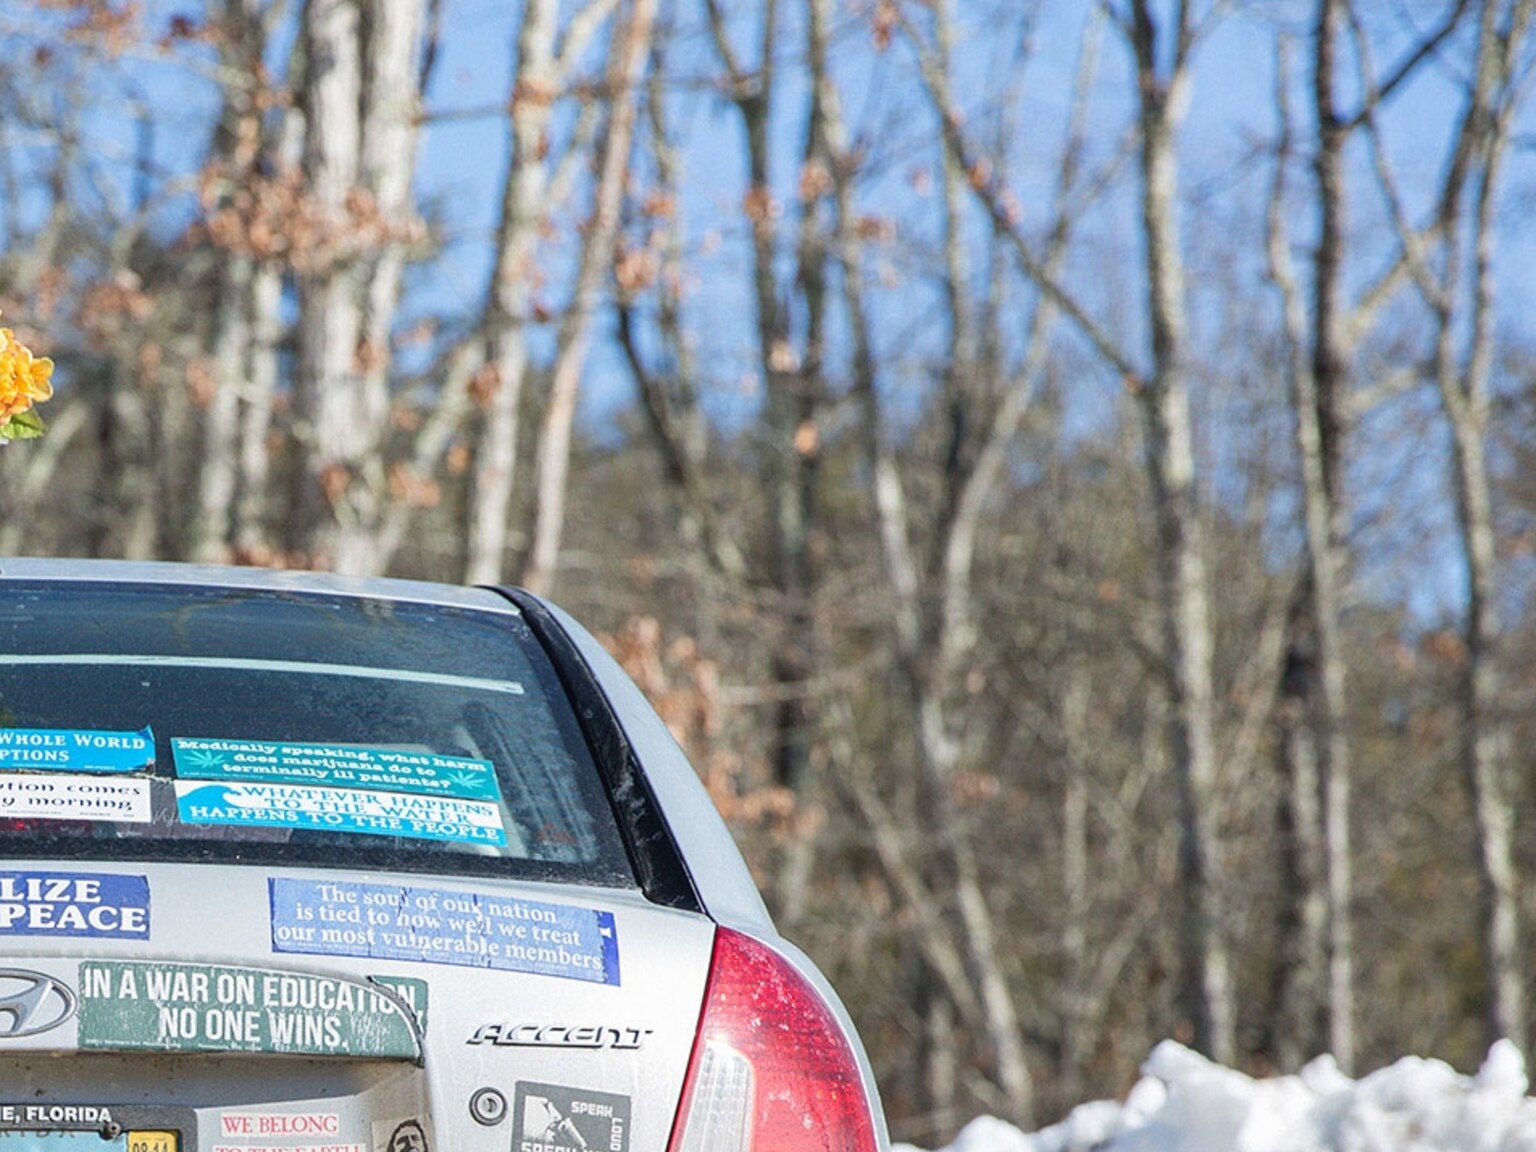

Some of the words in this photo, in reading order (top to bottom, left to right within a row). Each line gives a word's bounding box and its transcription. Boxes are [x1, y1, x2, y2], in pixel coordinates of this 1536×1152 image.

[74, 735, 145, 749] WORLD
[84, 970, 114, 998] IN
[119, 971, 139, 999] A
[146, 971, 212, 1002] WAR
[217, 975, 256, 1005] ON
[161, 1011, 202, 1039] NO
[205, 1011, 260, 1041] ONE
[269, 1012, 349, 1047] WINS.
[466, 1024, 653, 1049] ACCENT
[26, 1108, 112, 1122] FLORIDA
[571, 1101, 613, 1116] SPEAK
[223, 1116, 252, 1133] WE
[259, 1116, 337, 1133] BELONG
[610, 1117, 623, 1151] LOUD
